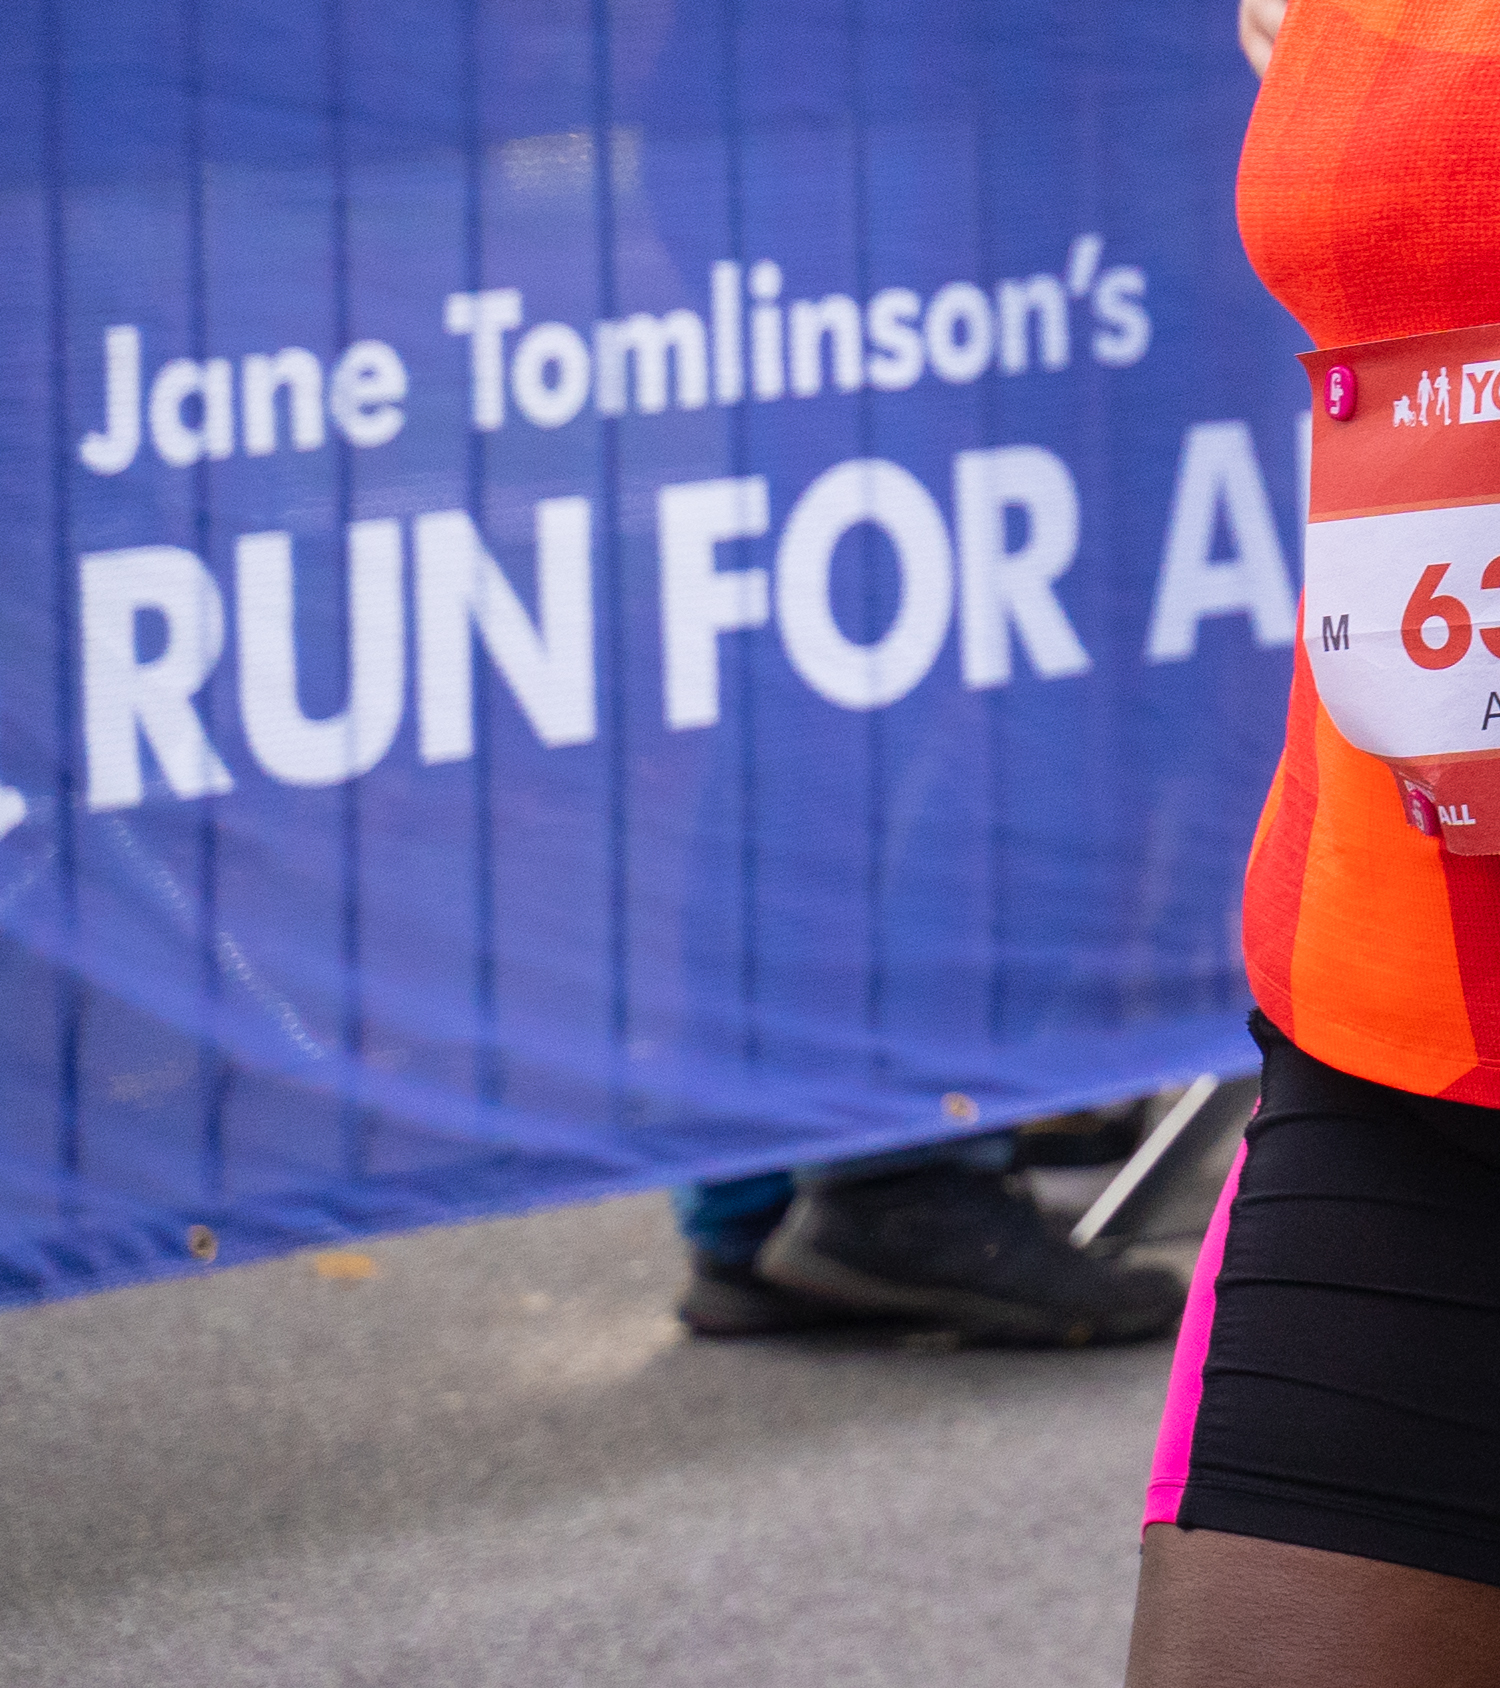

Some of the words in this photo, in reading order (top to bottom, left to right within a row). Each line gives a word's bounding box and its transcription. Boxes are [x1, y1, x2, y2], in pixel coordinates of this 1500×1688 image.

[80, 324, 408, 476] Jane
[445, 233, 1151, 432] Tomlinson's
[79, 495, 598, 813] RUN
[658, 444, 1093, 733] FOR
[1322, 613, 1352, 652] M
[1437, 803, 1477, 826] ALL
